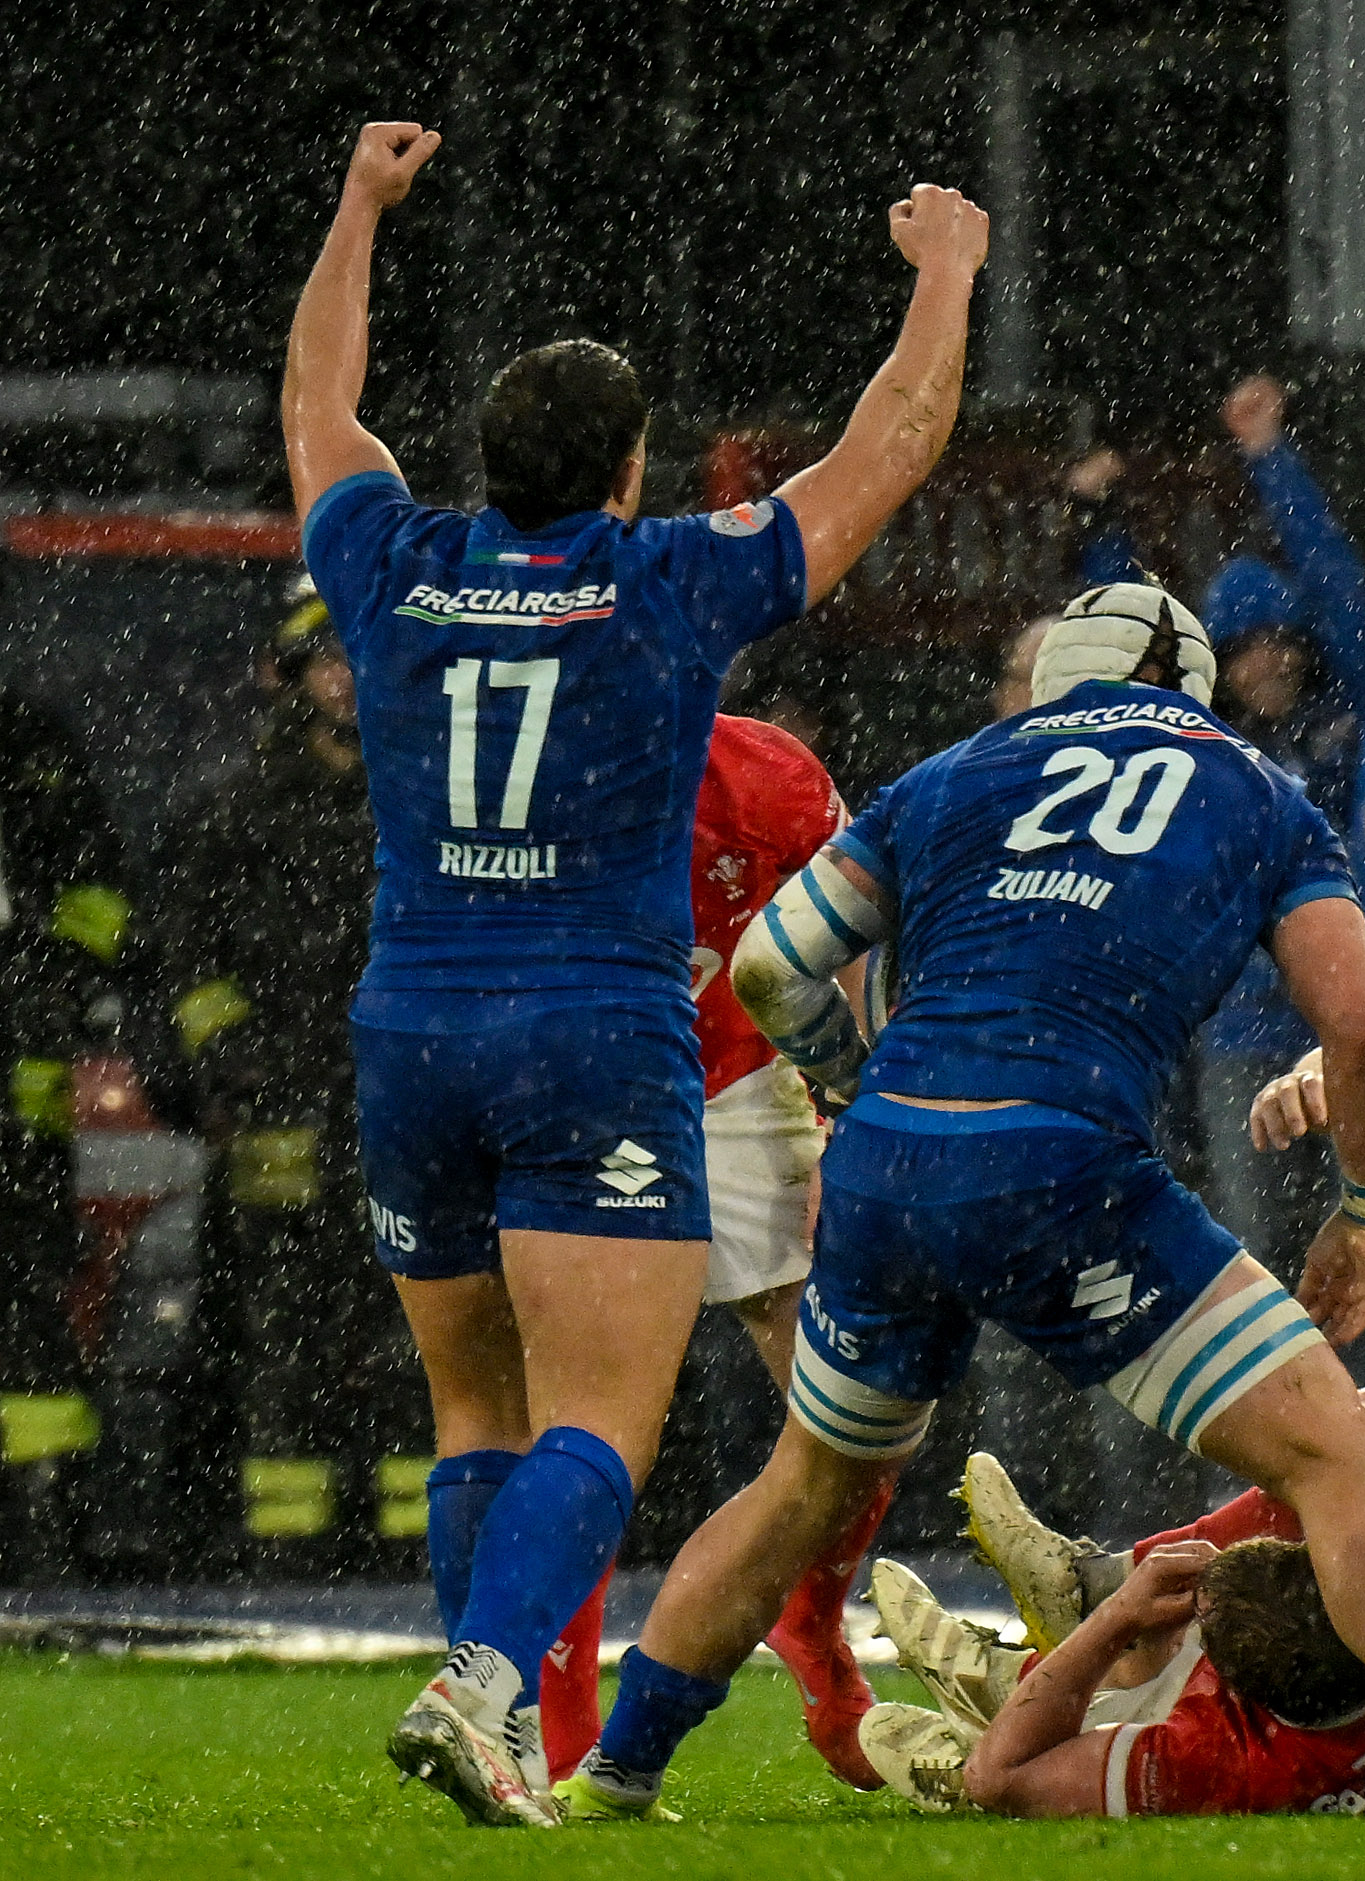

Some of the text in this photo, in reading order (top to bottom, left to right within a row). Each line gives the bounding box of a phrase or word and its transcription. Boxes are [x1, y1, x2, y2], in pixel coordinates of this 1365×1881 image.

[443, 658, 560, 830] 17
[1004, 746, 1196, 855] 20
[440, 842, 557, 879] RIZZOLI
[987, 868, 1115, 911] ZULIANI
[595, 1195, 667, 1209] SUZUKI
[806, 1282, 861, 1361] AVIS
